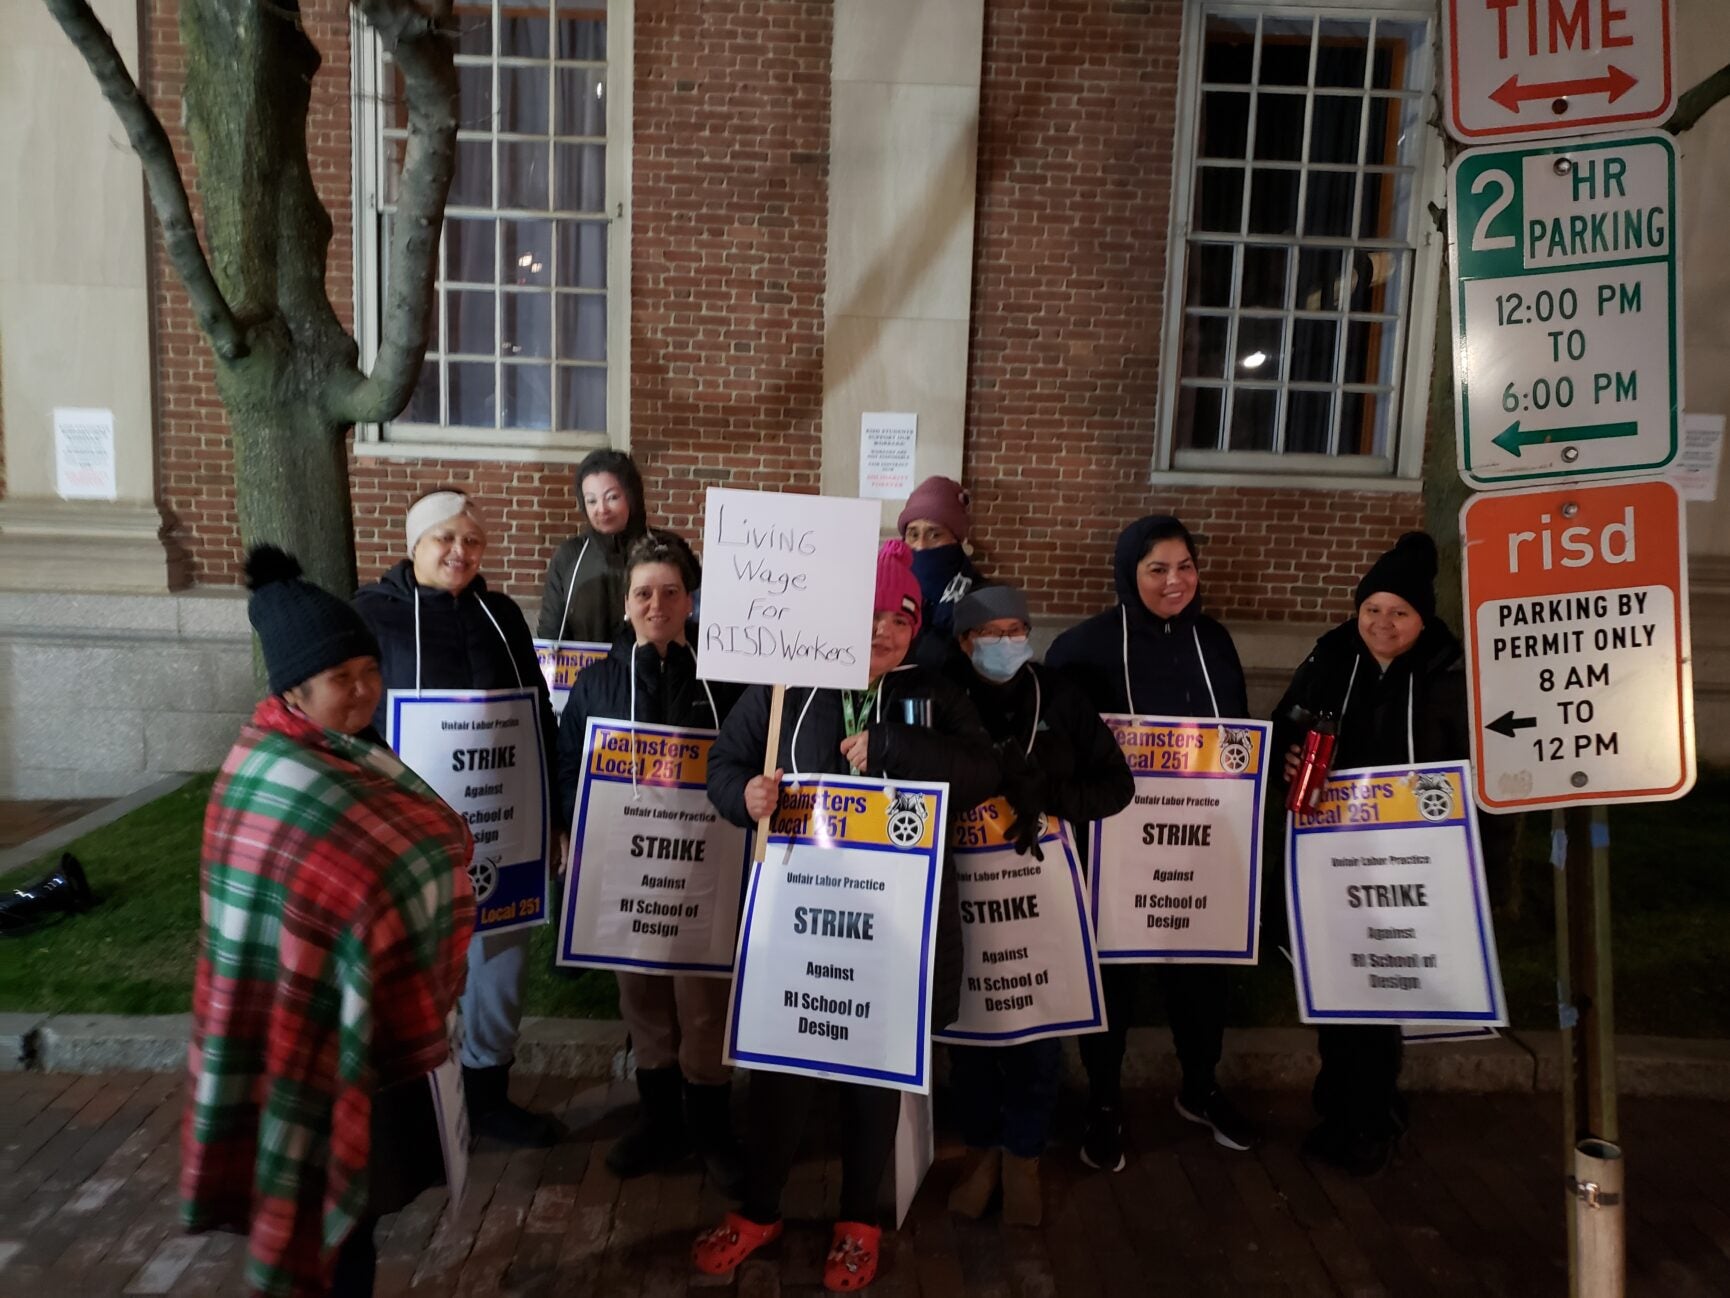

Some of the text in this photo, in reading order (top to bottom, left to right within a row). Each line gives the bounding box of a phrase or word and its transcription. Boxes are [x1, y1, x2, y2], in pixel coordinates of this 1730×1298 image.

[1486, 0, 1634, 59] TIME
[1470, 157, 1627, 251] 2 HR
[1528, 206, 1665, 259] PARKING
[1495, 281, 1642, 326] 12:00 PM
[1547, 329, 1586, 362] TO
[1502, 370, 1637, 412] 6:00 PM
[1508, 505, 1636, 574] risd
[733, 554, 808, 595] Wage
[747, 598, 790, 620] For
[1499, 591, 1648, 627] PARKING BY
[706, 622, 856, 665] RISD Workers
[1493, 623, 1656, 660] PERMIT ONLY
[1539, 663, 1610, 692] 8 AM
[1556, 699, 1595, 724] TO
[600, 730, 700, 760] Teamsters
[1112, 727, 1204, 749] eamsters
[1533, 732, 1619, 761] 12 PM
[452, 745, 516, 772] STRIKE
[595, 753, 682, 780] Local 251
[1127, 750, 1189, 770] cal 251
[464, 783, 504, 798] Against
[1134, 795, 1220, 808] Unfair Labor Practice
[503, 806, 515, 820] of
[624, 806, 716, 823] Unfair Labor Practice
[1348, 803, 1380, 823] 251
[957, 825, 988, 846] 251
[1142, 823, 1212, 847] STRIKE
[630, 833, 706, 862] STRIKE
[640, 874, 686, 891] Against
[786, 872, 886, 892] Unfair Labor Practice
[973, 871, 1000, 882] Labor
[1001, 865, 1042, 880] Practice
[1152, 869, 1194, 884] Against
[1134, 894, 1208, 910] RI School of
[1346, 883, 1429, 908] STRIKE
[481, 902, 516, 925] Local
[620, 898, 699, 919] RI School of
[960, 894, 1040, 925] STRIKE
[632, 919, 679, 937] Design
[793, 906, 874, 941] STRIKE
[1146, 914, 1190, 931] Design
[1367, 926, 1417, 940] Against
[982, 946, 1029, 964] Against
[805, 960, 855, 981] Against
[967, 969, 1049, 992] RI School of
[1368, 974, 1422, 991] Design
[783, 989, 871, 1019] RI School of
[984, 993, 1034, 1012] Design
[797, 1016, 849, 1041] Design
